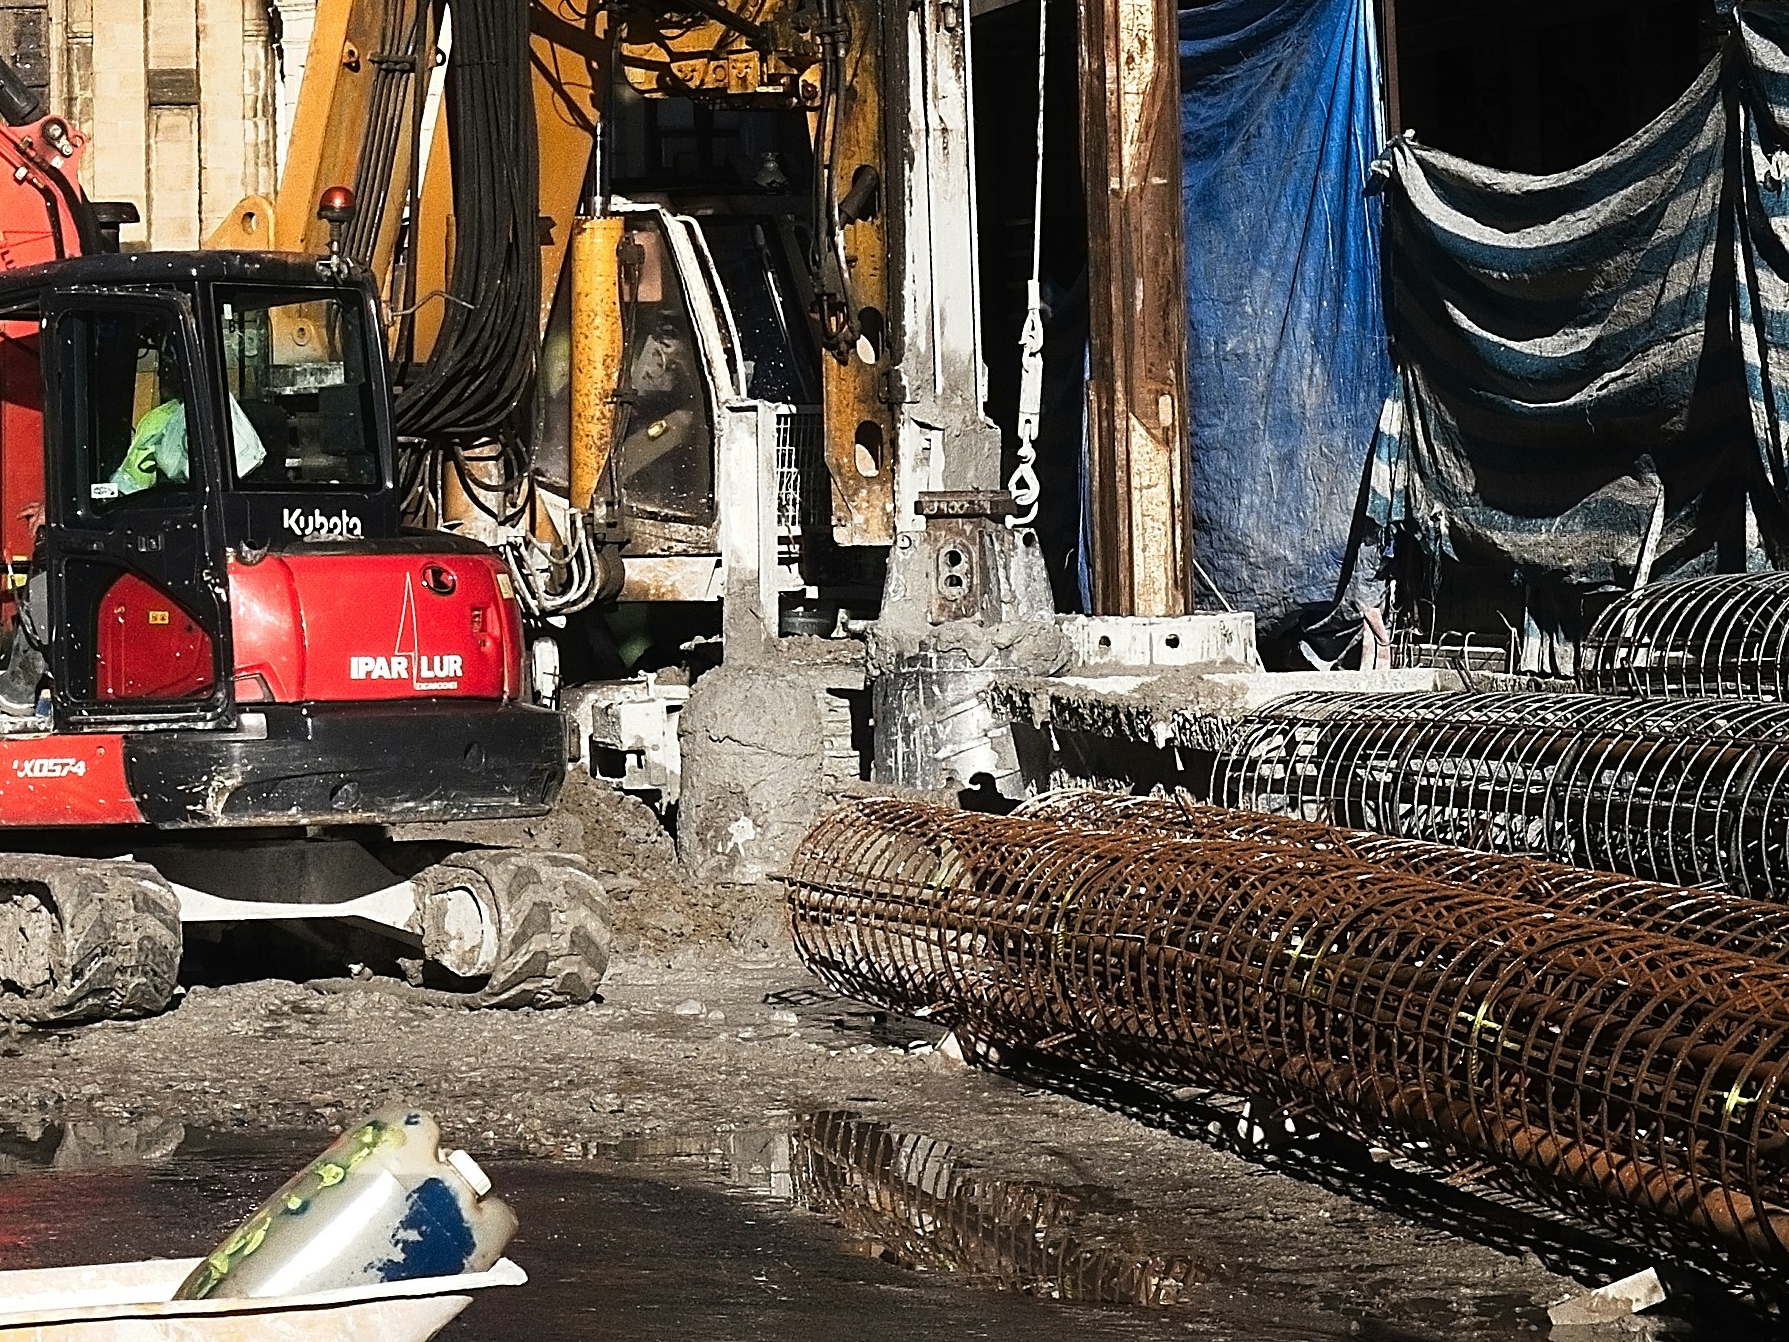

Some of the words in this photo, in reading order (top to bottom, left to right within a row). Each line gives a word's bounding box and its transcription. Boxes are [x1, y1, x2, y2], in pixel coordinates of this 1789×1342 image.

[283, 508, 362, 536] Kubota
[349, 656, 409, 680] IPAR
[420, 655, 463, 678] LUR
